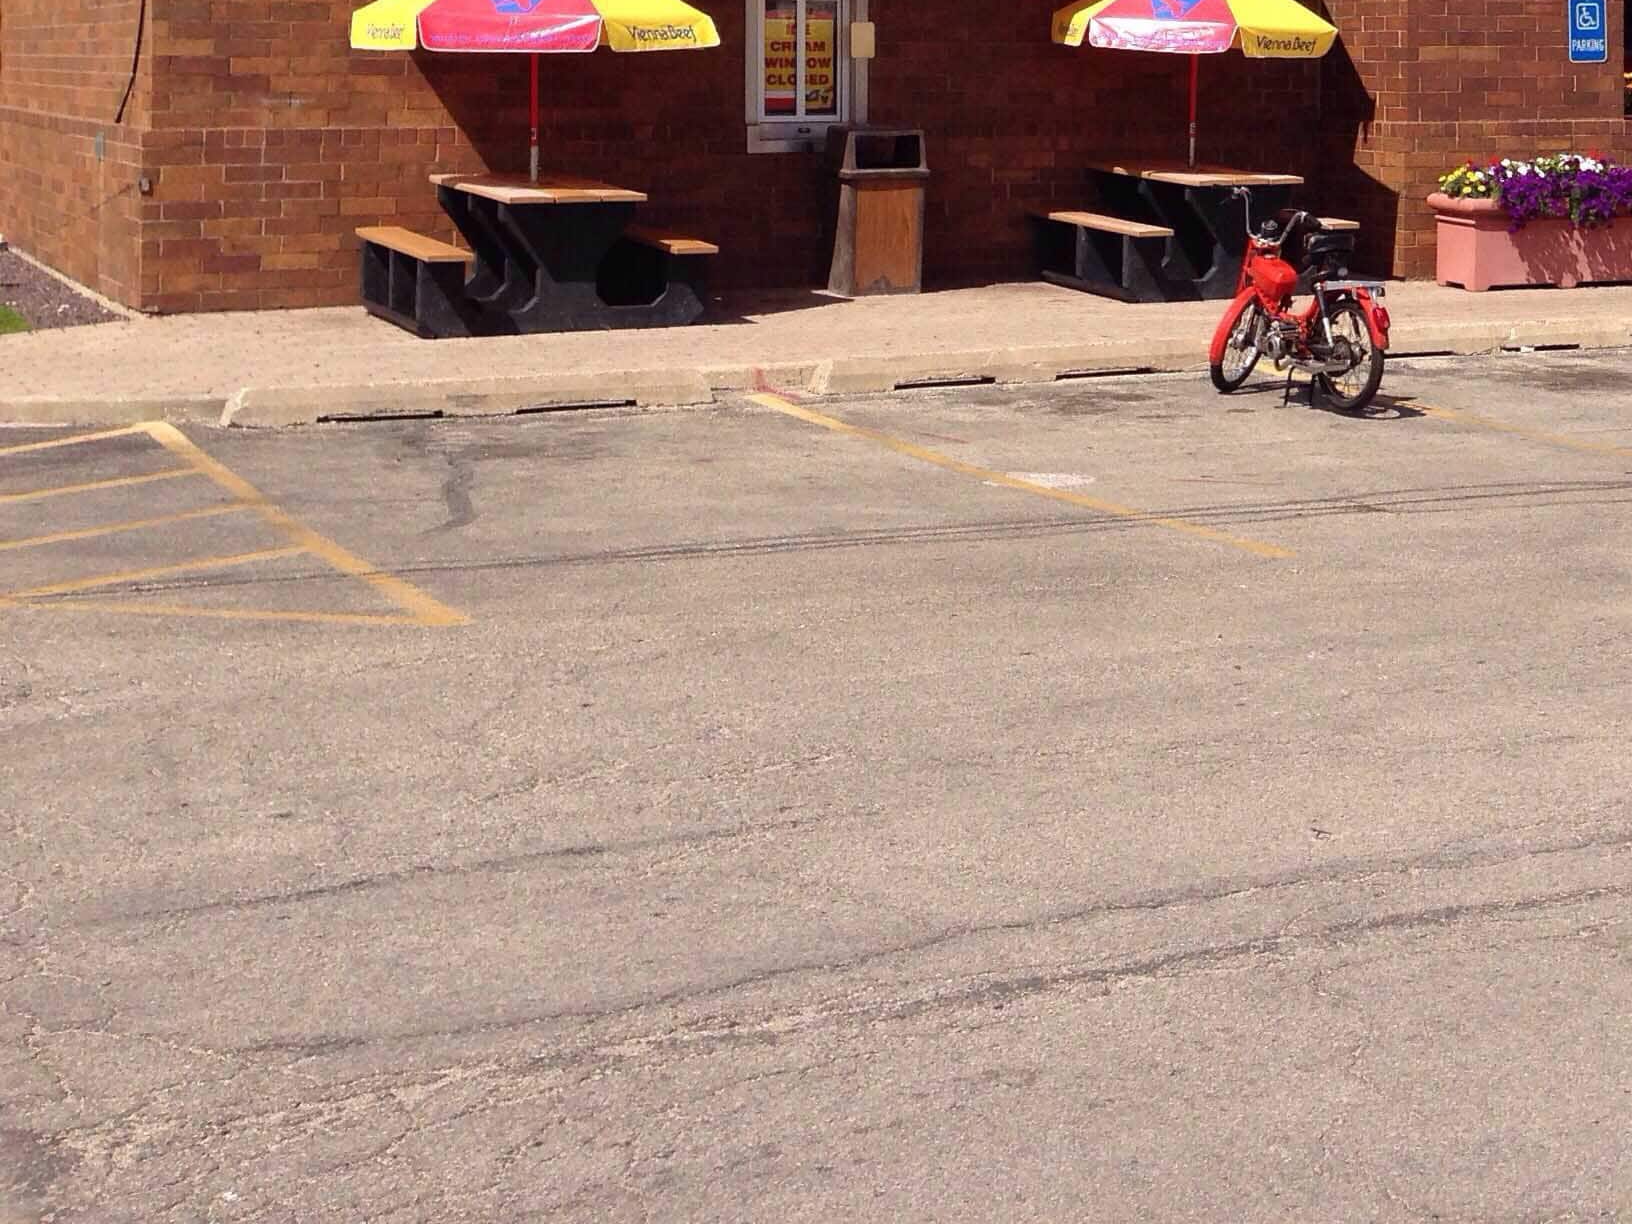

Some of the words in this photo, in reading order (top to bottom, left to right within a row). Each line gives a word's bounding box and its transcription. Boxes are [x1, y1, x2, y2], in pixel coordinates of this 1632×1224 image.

[1571, 39, 1605, 52] PARKING
[765, 57, 832, 69] WINOW
[766, 74, 829, 85] CLOED
